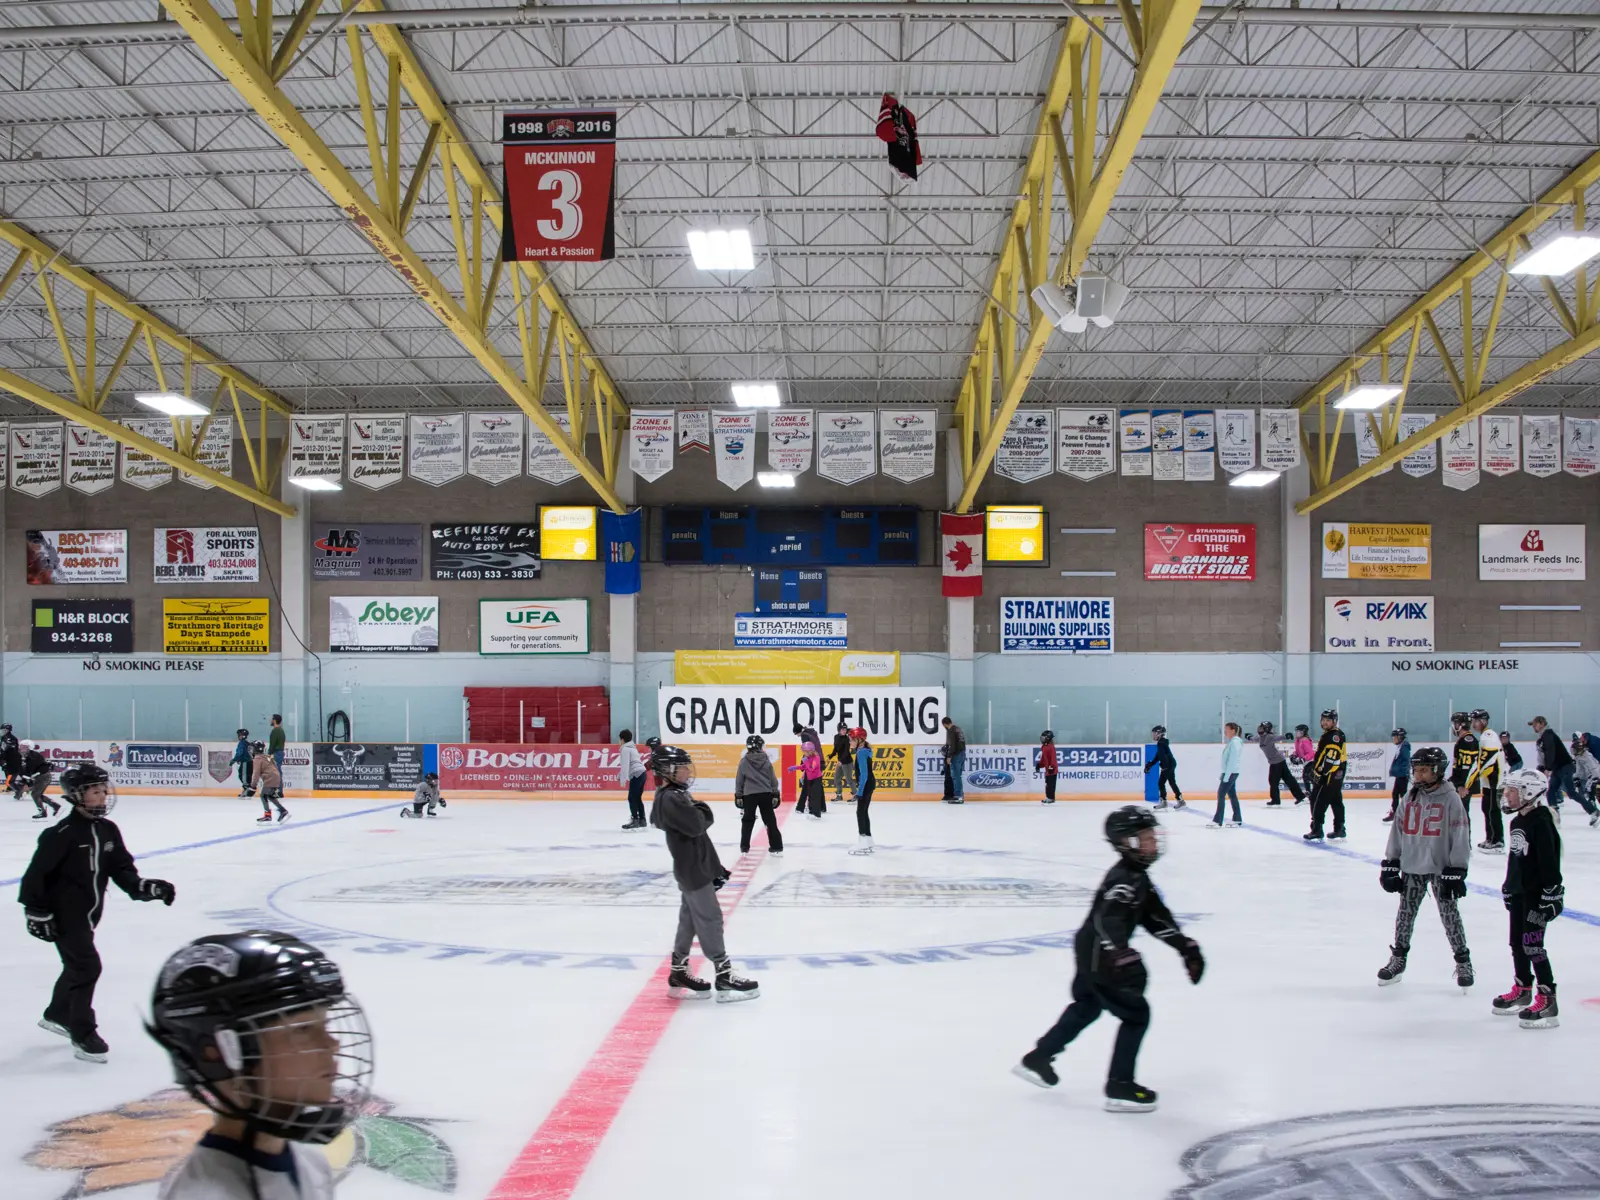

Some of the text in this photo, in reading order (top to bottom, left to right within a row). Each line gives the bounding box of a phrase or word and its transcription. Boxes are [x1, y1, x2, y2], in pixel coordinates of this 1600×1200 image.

[510, 122, 543, 134] 1998
[577, 120, 611, 132] 2016
[525, 151, 596, 164] MCKINNON
[536, 169, 582, 240] 3
[525, 246, 594, 256] Heart & Passion
[412, 445, 462, 460] Champions
[470, 445, 520, 460] Champions
[820, 444, 872, 458] Champions
[882, 443, 934, 456] Champions
[294, 466, 340, 476] Champions
[354, 466, 401, 478] Champions
[16, 475, 60, 487] Champions
[70, 471, 114, 484] Champions
[841, 510, 864, 519] Guests
[432, 526, 536, 538] REFINISH FX
[672, 532, 697, 540] penalty
[1350, 527, 1429, 536] HARVEST FINANCIAL
[58, 532, 122, 546] BRO-TECH
[207, 539, 254, 549] SPORTS
[1188, 534, 1246, 543] CANADIAN
[442, 540, 472, 549] AUTO
[779, 542, 802, 552] period
[1205, 544, 1229, 552] TIRE
[314, 558, 360, 569] Magnum
[386, 557, 418, 566] Operations
[1482, 555, 1582, 564] Landmark Feeds Inc.
[156, 566, 205, 577] REBEL SPORTS
[1151, 564, 1250, 574] HOCKEY STORE
[458, 571, 481, 580] (403)
[760, 572, 779, 580] Home
[798, 602, 810, 610] goal
[1005, 600, 1110, 619] STRATHMORE
[1366, 602, 1427, 621] RE/MAX
[58, 613, 129, 623] H&R BLOCK
[358, 601, 436, 625] Sobeys
[506, 611, 561, 623] UFA
[1005, 622, 1110, 636] BUILDING SUPPLIES
[52, 632, 112, 642] 934-3268
[544, 634, 578, 642] community
[1329, 637, 1356, 647] Out
[1365, 637, 1380, 647] in
[83, 661, 204, 670] NO SMOKING PLEASE
[1392, 660, 1519, 670] NO SMOKING PLEASE
[666, 696, 938, 735] GRAND OPENING
[129, 750, 197, 766] Travelodge
[466, 749, 572, 768] Boston
[1035, 751, 1140, 764] 43-934-2100
[976, 772, 1006, 785] Ford
